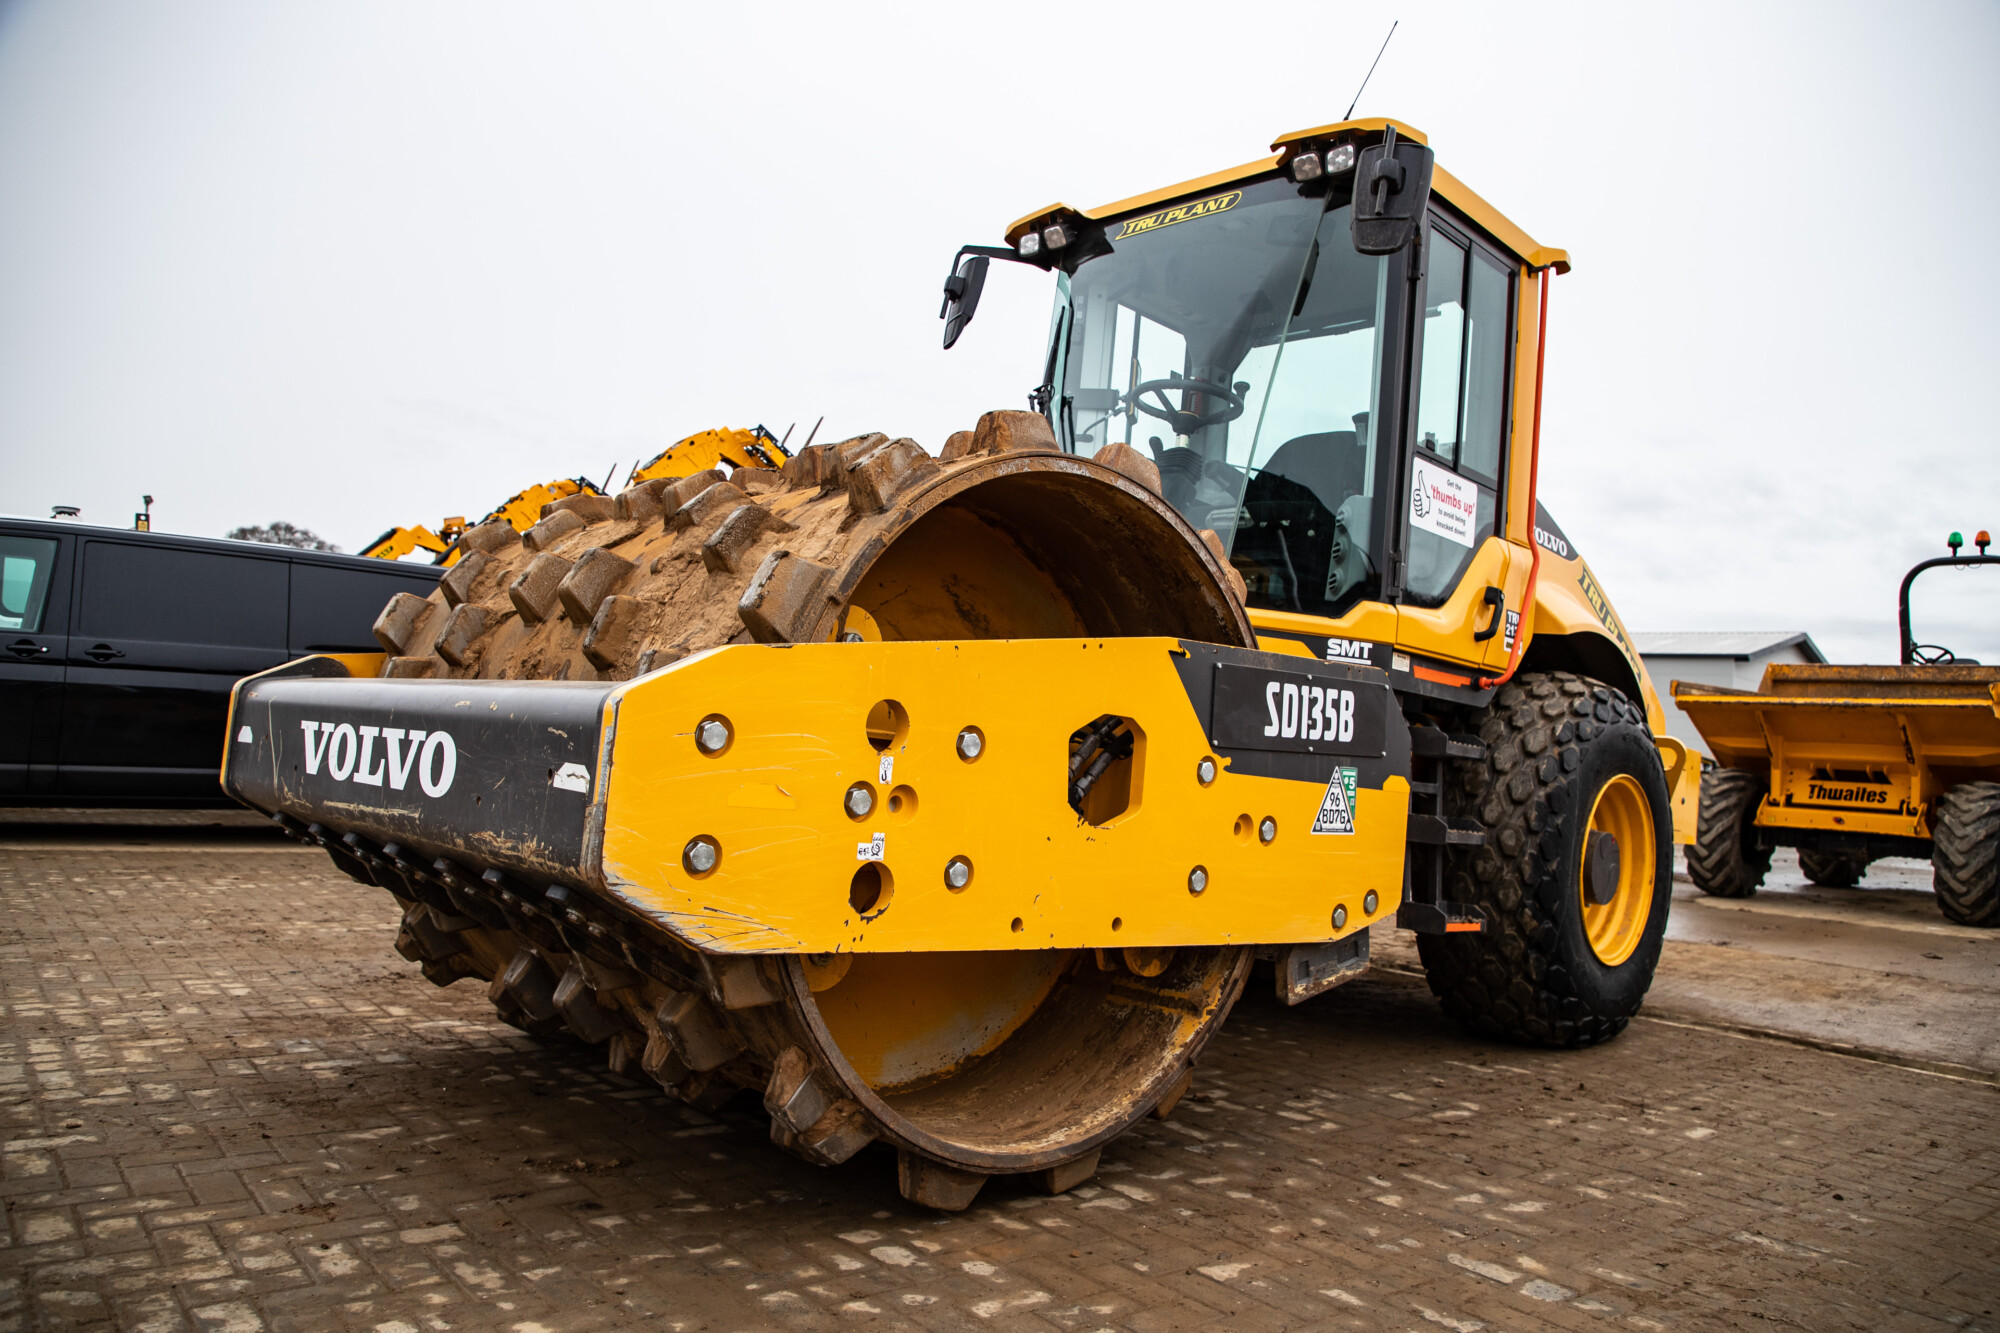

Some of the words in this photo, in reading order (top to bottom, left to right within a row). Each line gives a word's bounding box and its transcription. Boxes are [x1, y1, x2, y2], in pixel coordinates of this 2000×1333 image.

[1126, 214, 1164, 234] TRU
[1164, 195, 1234, 223] PLANT
[1447, 479, 1455, 487] Get
[1436, 520, 1453, 532] knocked
[1443, 511, 1454, 520] avoid
[1455, 516, 1466, 526] being
[1533, 526, 1567, 557] OLVO
[1582, 571, 1606, 619] TRU
[1327, 638, 1373, 660] SMT
[1264, 681, 1355, 743] SD135B
[301, 720, 457, 798] VOLVO
[1329, 792, 1341, 807] 96
[1808, 784, 1888, 804] Thwaites
